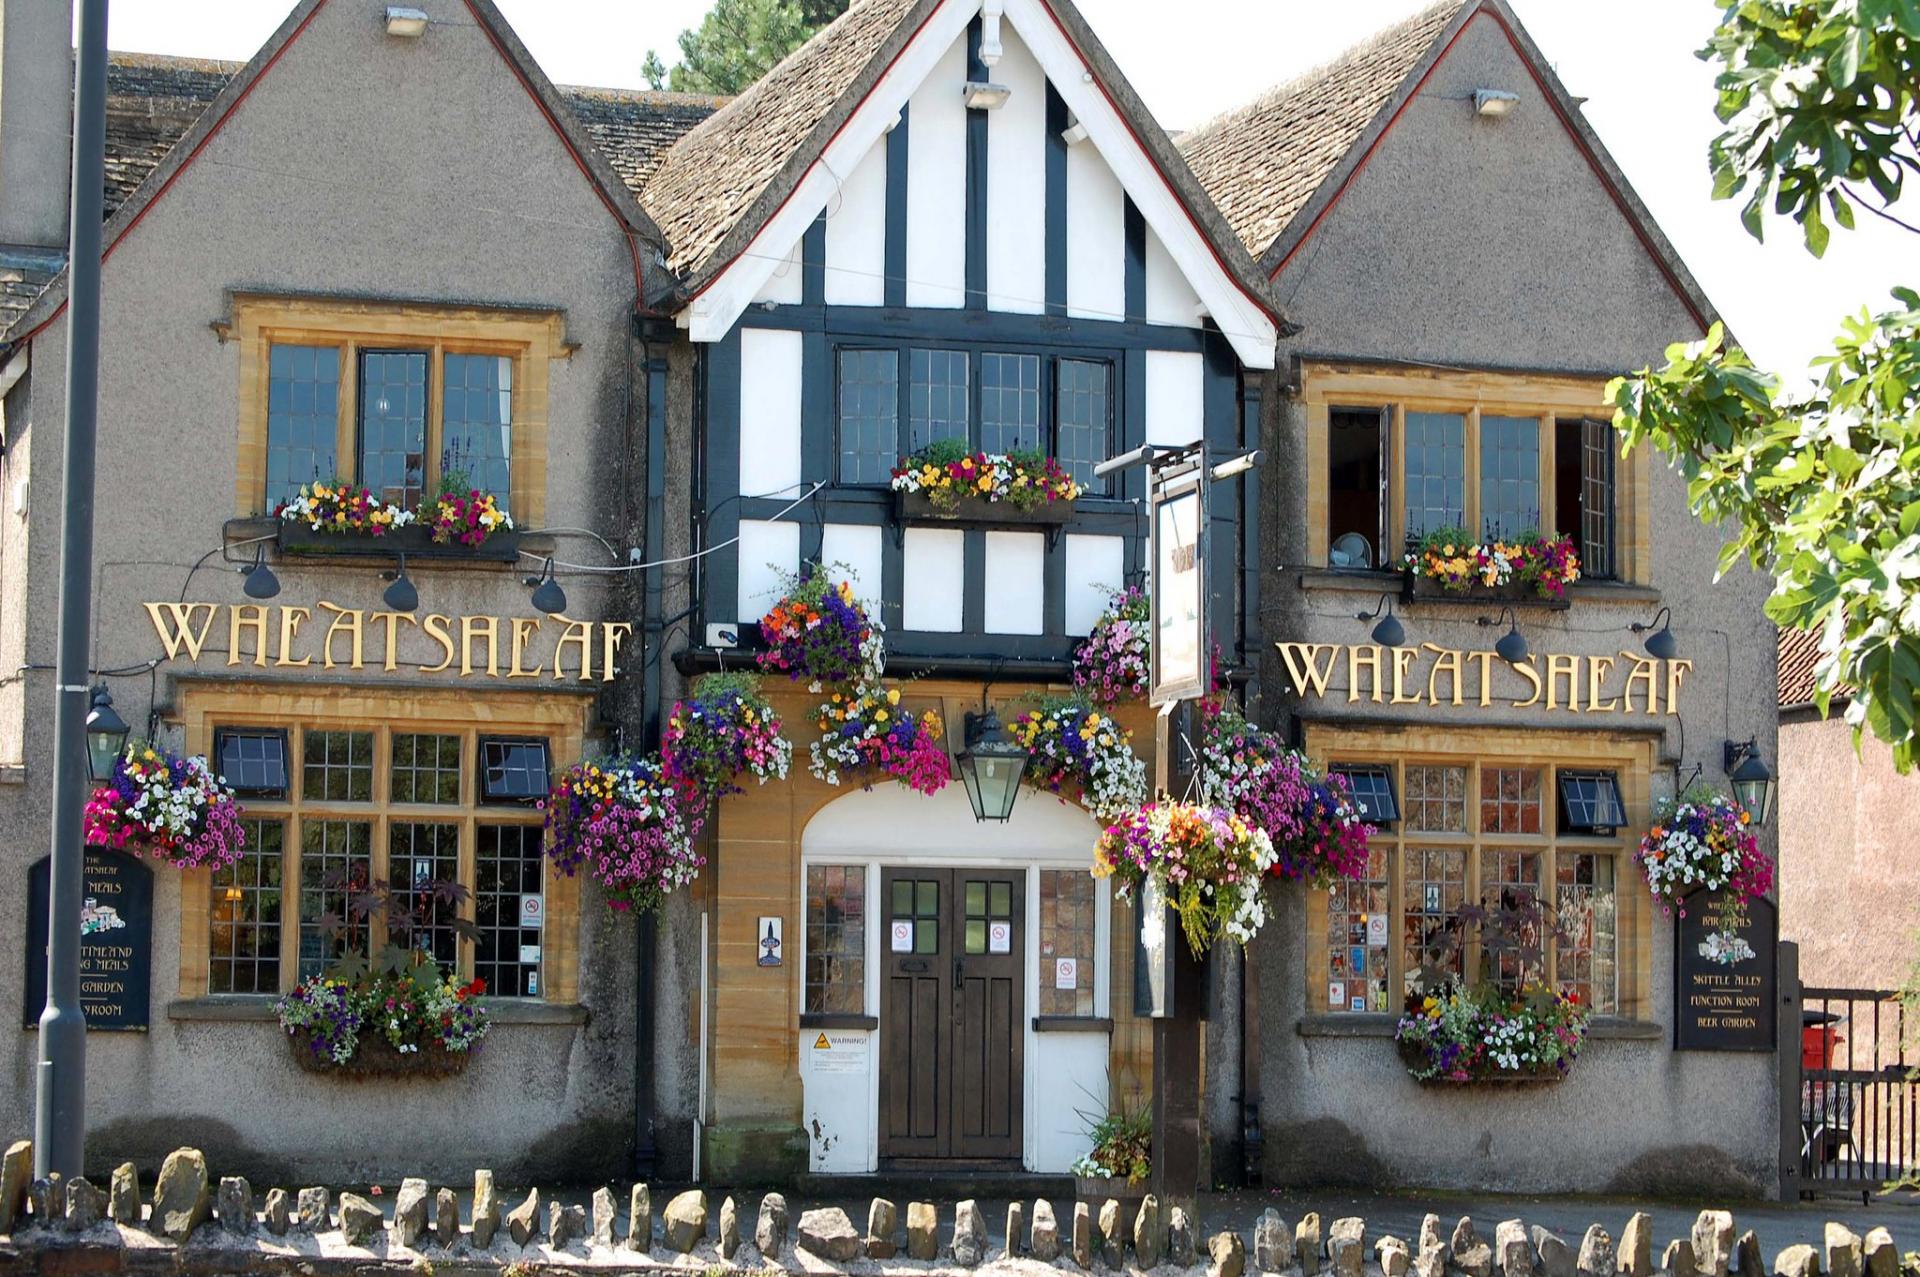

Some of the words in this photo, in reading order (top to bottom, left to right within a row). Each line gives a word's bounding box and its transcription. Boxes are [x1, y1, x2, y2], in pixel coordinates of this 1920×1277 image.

[142, 600, 633, 683] WHEATSHEAF
[1274, 641, 1693, 716] WHEATSHEAF
[88, 880, 122, 894] MEALS
[96, 959, 129, 971] MEALS
[82, 981, 124, 993] GARDEN
[1693, 974, 1730, 986] SKITTLE
[1734, 974, 1761, 987] ALLEY
[1690, 995, 1732, 1007] FUNCTION
[1736, 995, 1760, 1008] ROOM
[1697, 1017, 1718, 1028] BEER
[1721, 1016, 1756, 1028] GARDEN
[830, 1036, 867, 1046] WARNING!
